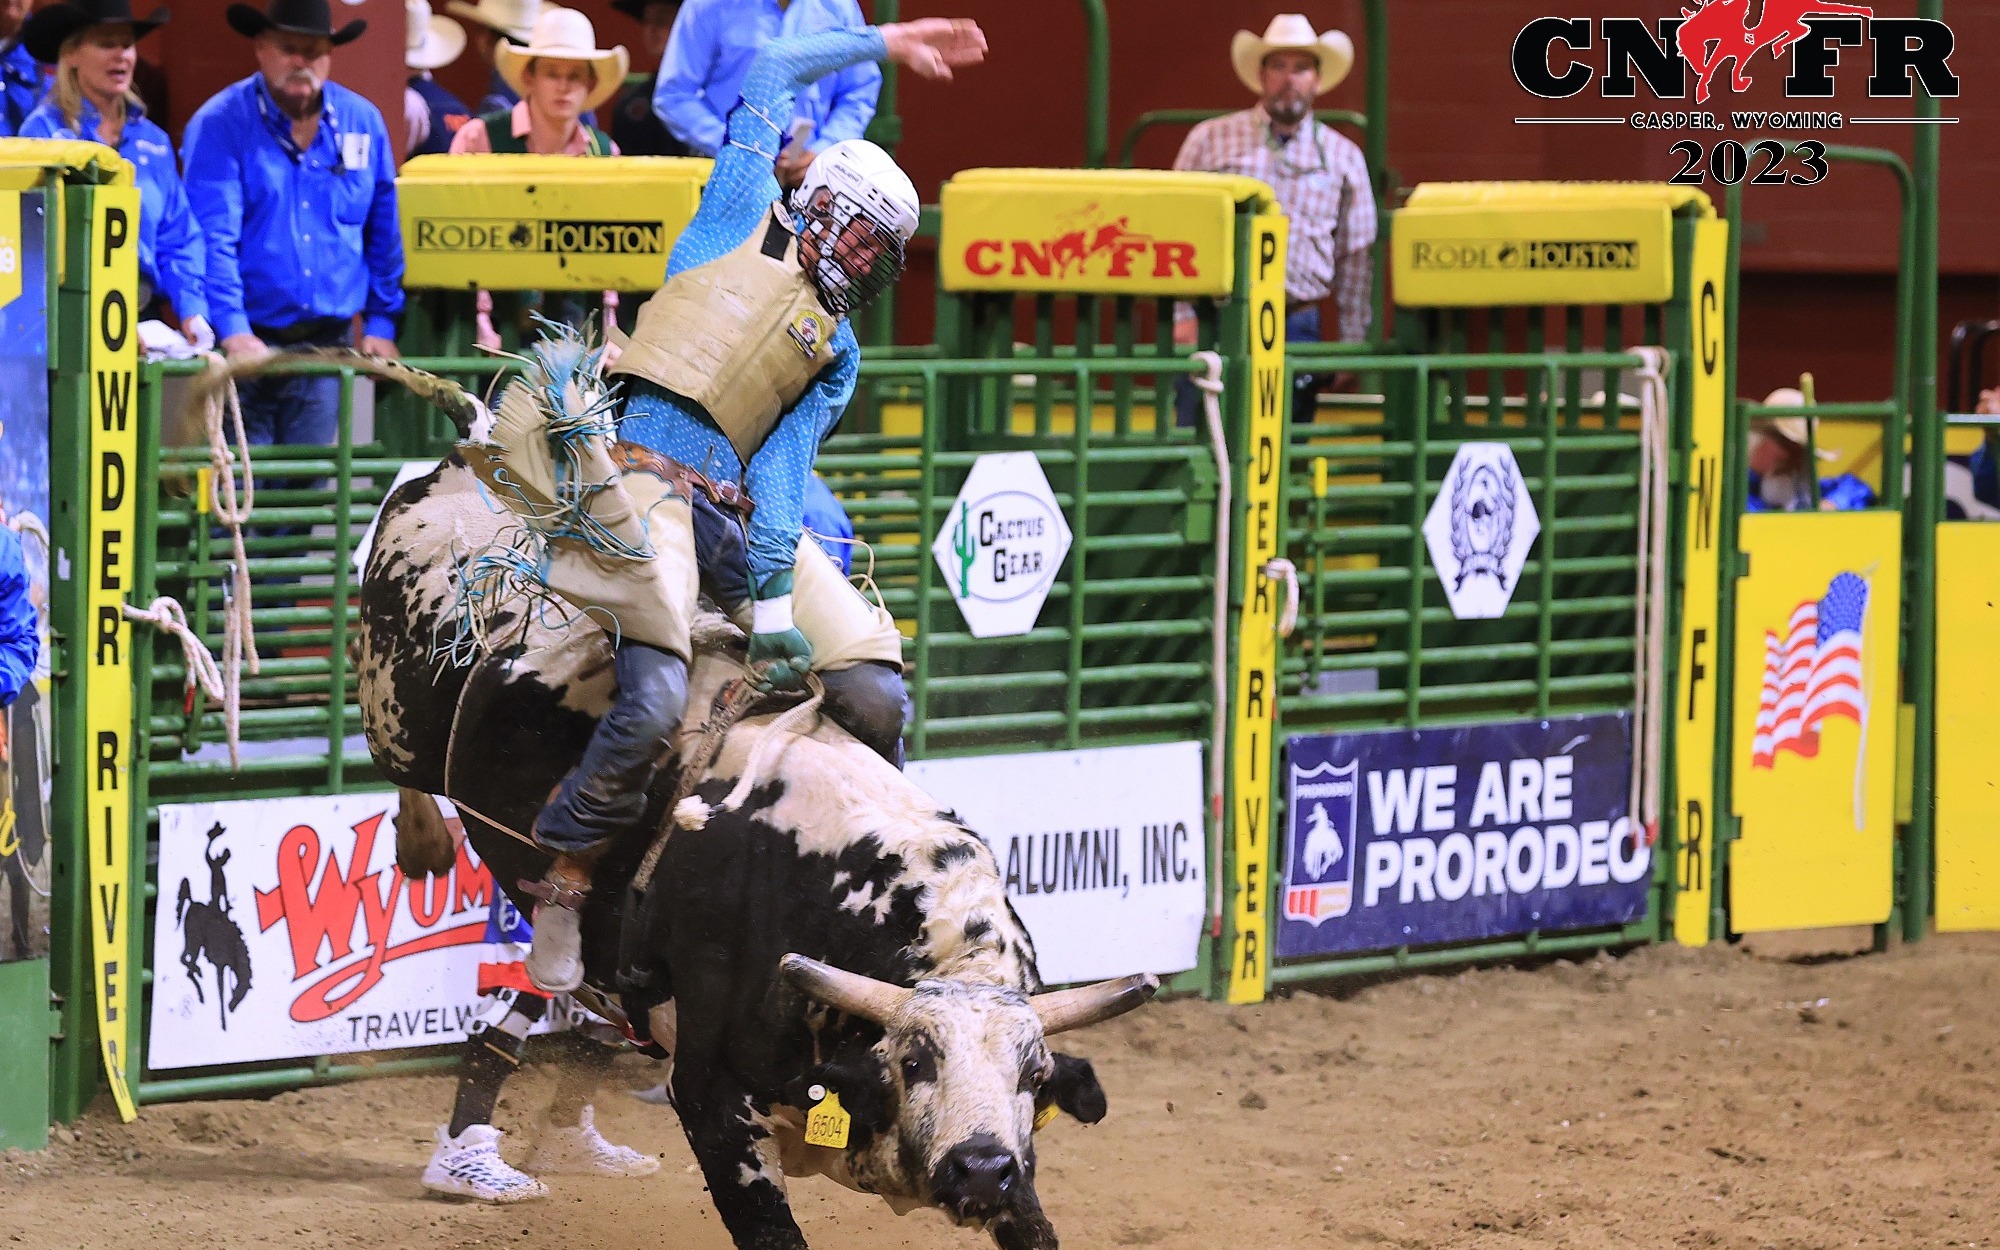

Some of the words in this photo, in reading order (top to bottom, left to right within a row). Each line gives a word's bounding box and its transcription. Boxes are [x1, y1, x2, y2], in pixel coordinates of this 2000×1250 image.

[539, 220, 663, 253] HOUSTON
[965, 240, 1198, 278] CNFR
[1525, 240, 1639, 269] HOUSTON
[97, 207, 132, 666] POWDER
[1254, 232, 1276, 613] POWDER
[979, 510, 1045, 547] CACTUS
[994, 548, 1043, 583] GEAR
[1680, 280, 1717, 893] CNFR
[1239, 669, 1264, 979] RIVER
[1366, 764, 1458, 836] WE
[1468, 754, 1574, 828] ARE
[1006, 827, 1129, 898] ALUMNI,
[1141, 821, 1197, 885] INC.
[1363, 816, 1651, 907] PRORODEO
[98, 730, 127, 1099] RIVER
[812, 1113, 844, 1139] 6504
